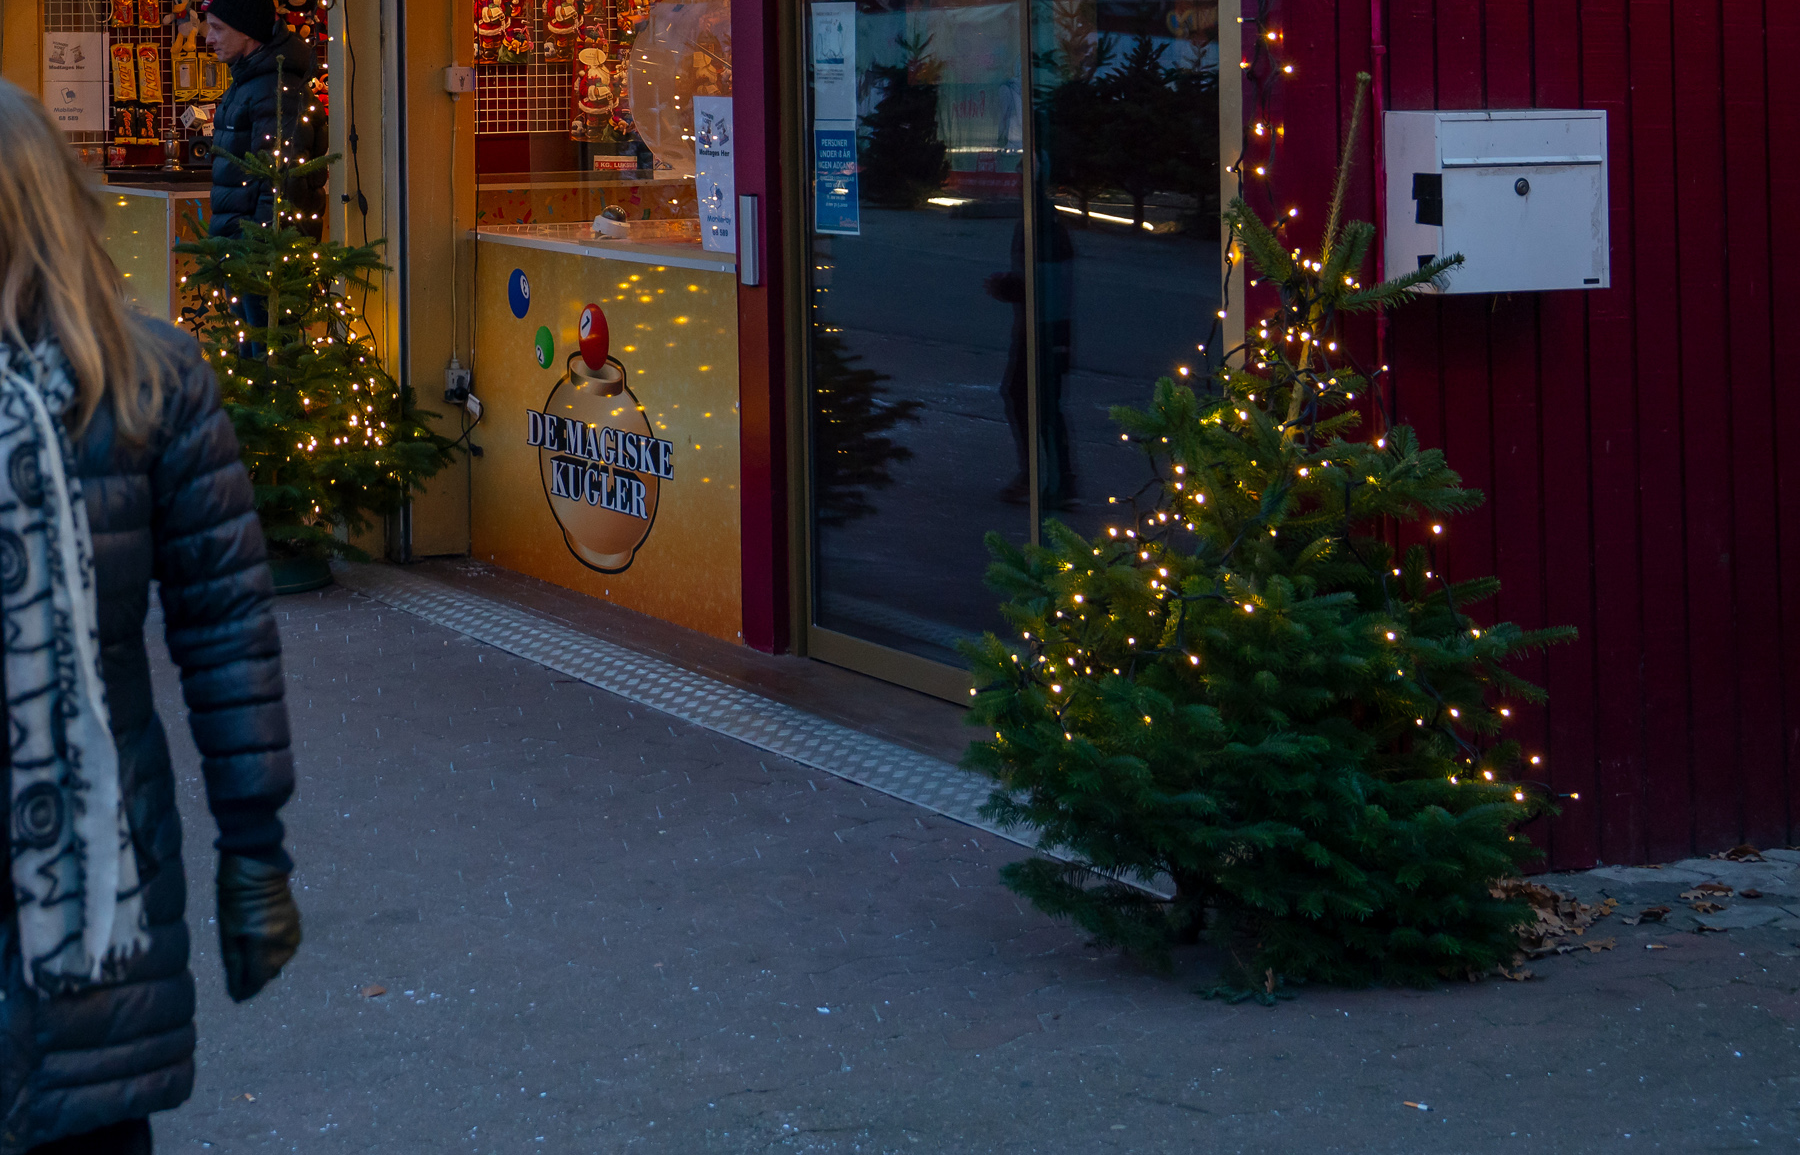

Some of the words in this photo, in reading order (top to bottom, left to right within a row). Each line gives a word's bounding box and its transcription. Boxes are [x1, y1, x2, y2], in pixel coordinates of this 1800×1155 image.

[720, 149, 730, 157] Her
[821, 138, 848, 147] PERSONER
[526, 408, 559, 451] DE
[563, 417, 674, 480] MAGISKE
[550, 457, 648, 519] KUGLER
